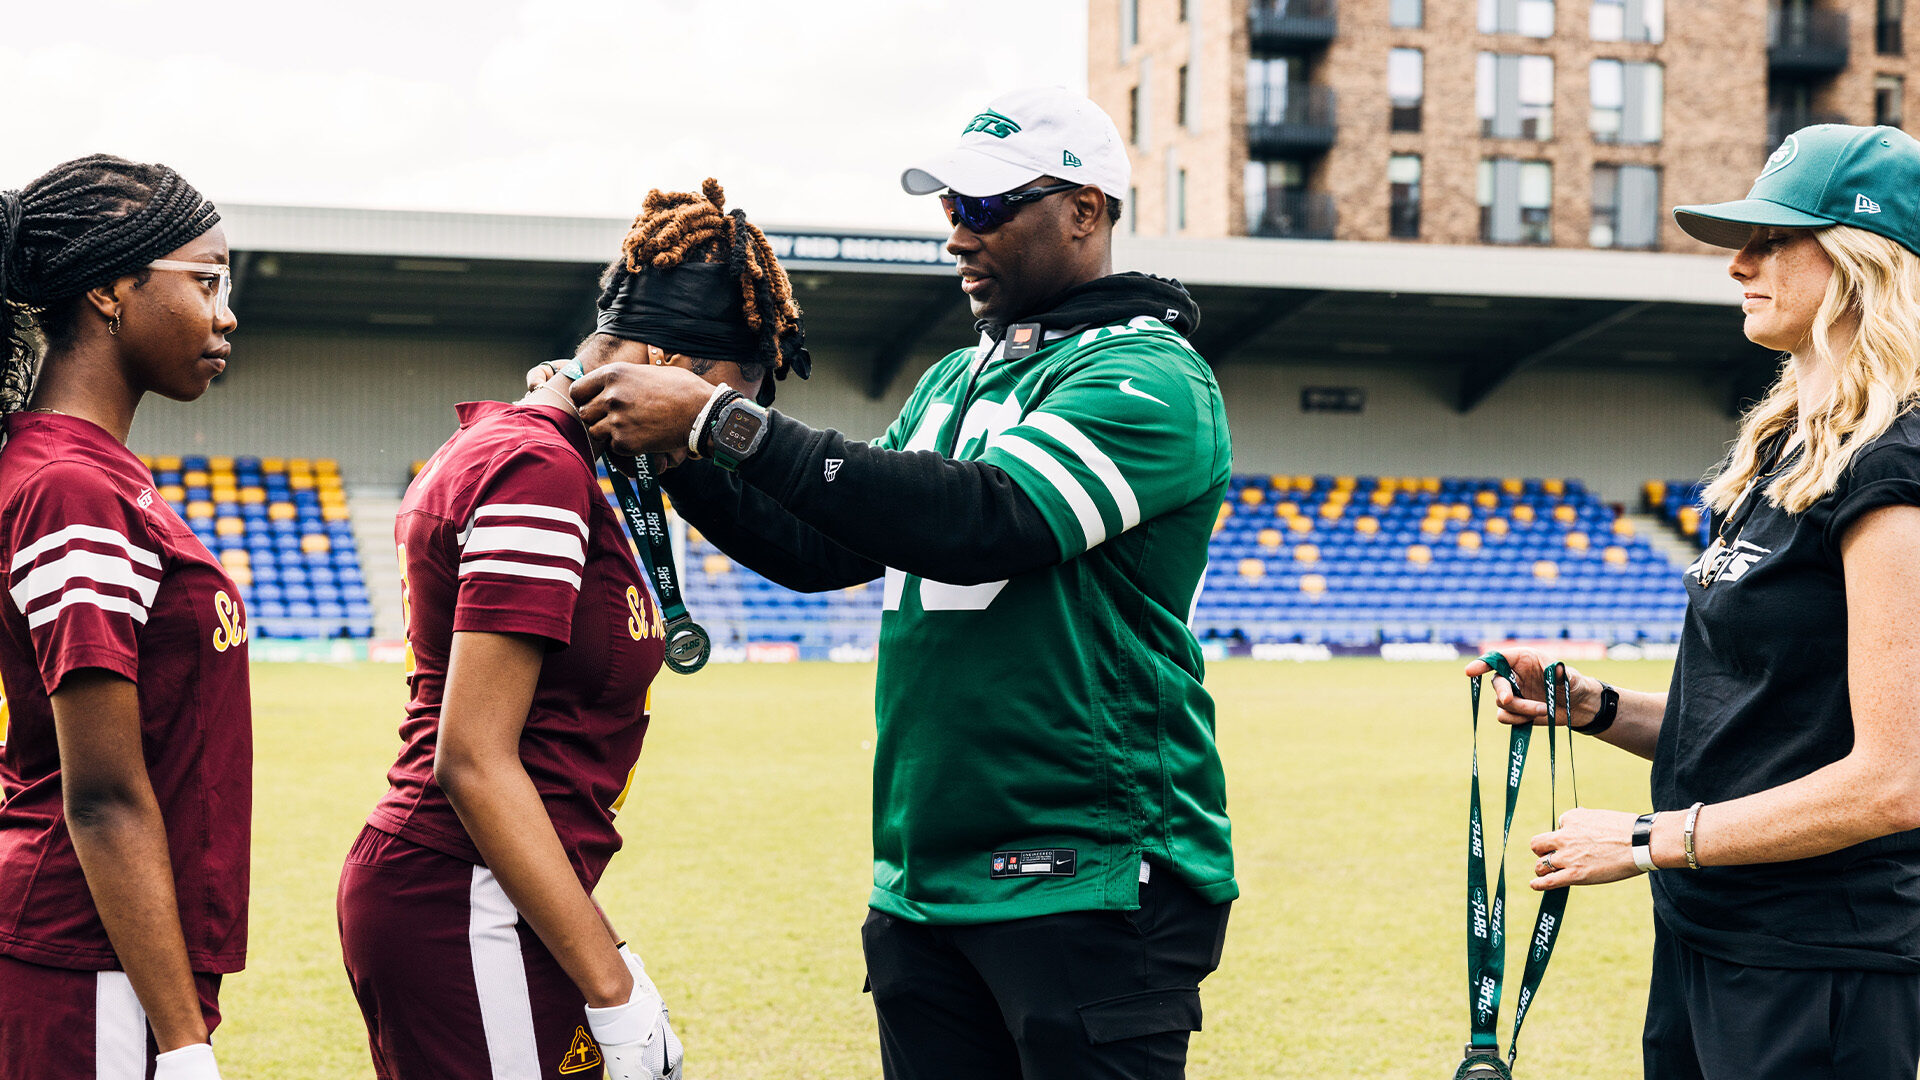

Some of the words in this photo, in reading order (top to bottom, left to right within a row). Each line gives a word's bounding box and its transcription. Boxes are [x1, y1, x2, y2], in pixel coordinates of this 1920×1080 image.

[961, 110, 1021, 139] ETS
[657, 566, 674, 590] FLAG
[1510, 751, 1523, 788] FLAG
[1471, 820, 1482, 858] FLAG
[1472, 900, 1487, 938] FLAG
[1492, 898, 1503, 936] FLAG
[1535, 913, 1556, 951] FLAG
[1478, 976, 1496, 1015] FLAG
[1516, 987, 1531, 1024] FLAG
